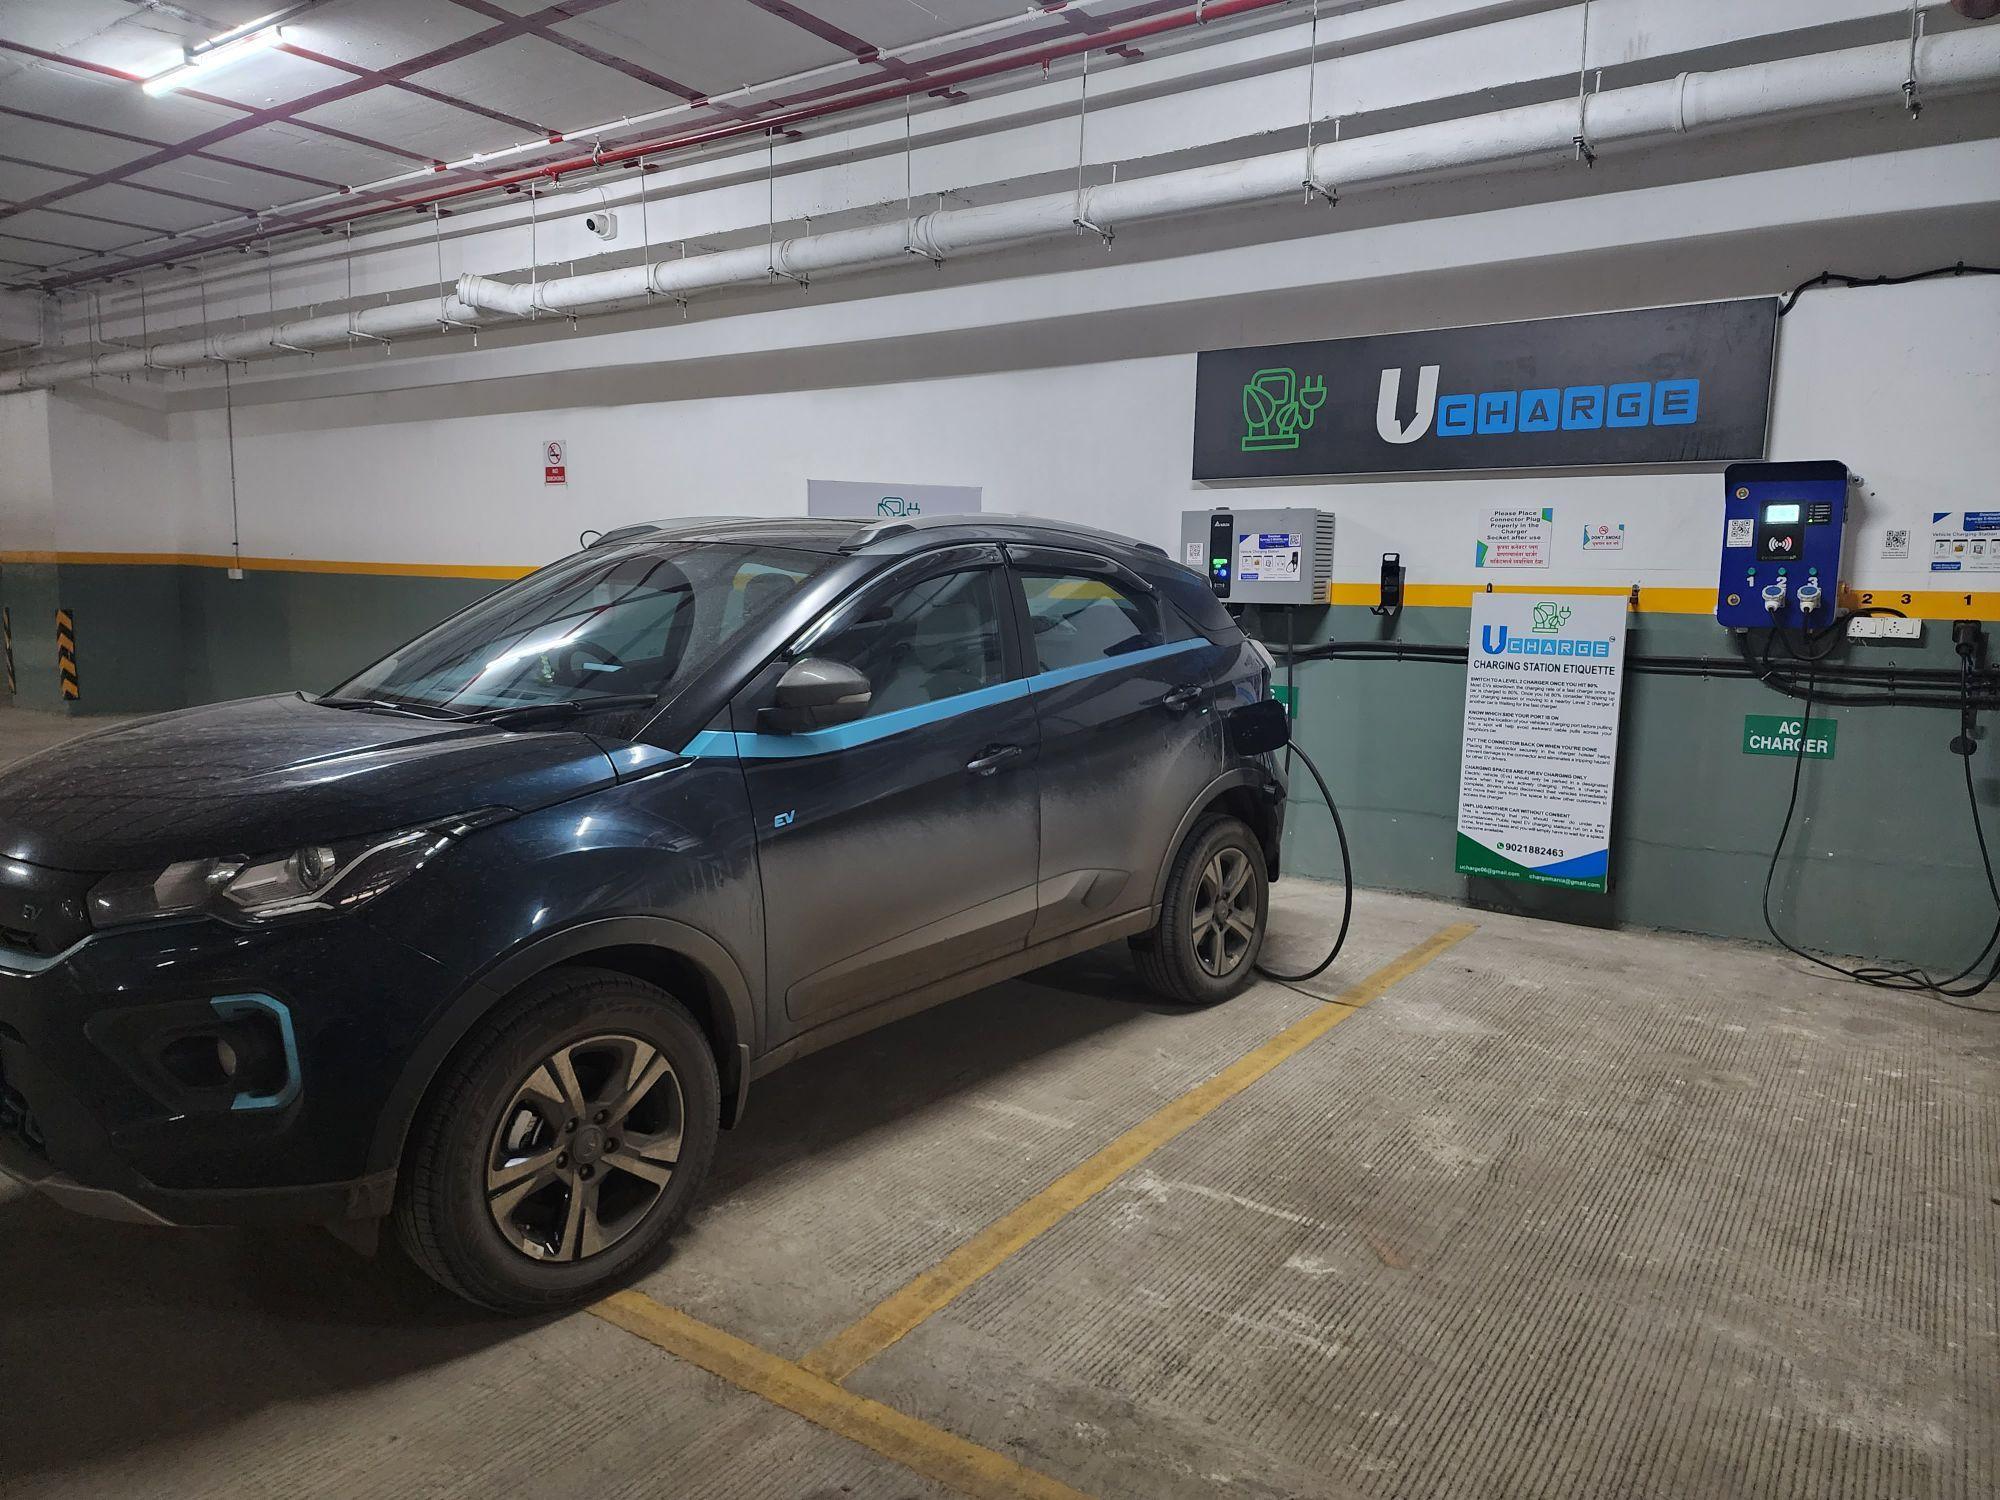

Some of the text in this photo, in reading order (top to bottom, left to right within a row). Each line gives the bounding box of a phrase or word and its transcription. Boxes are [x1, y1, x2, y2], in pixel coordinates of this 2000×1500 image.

[1746, 577, 1818, 587] 1 2 3
[1862, 594, 1972, 605] 2 3 1
[1473, 659, 1615, 676] CHARGING STATION ETIQUETTE
[1779, 721, 1801, 735] AC
[774, 810, 796, 828] EV
[1505, 842, 1564, 858] 9021882463
